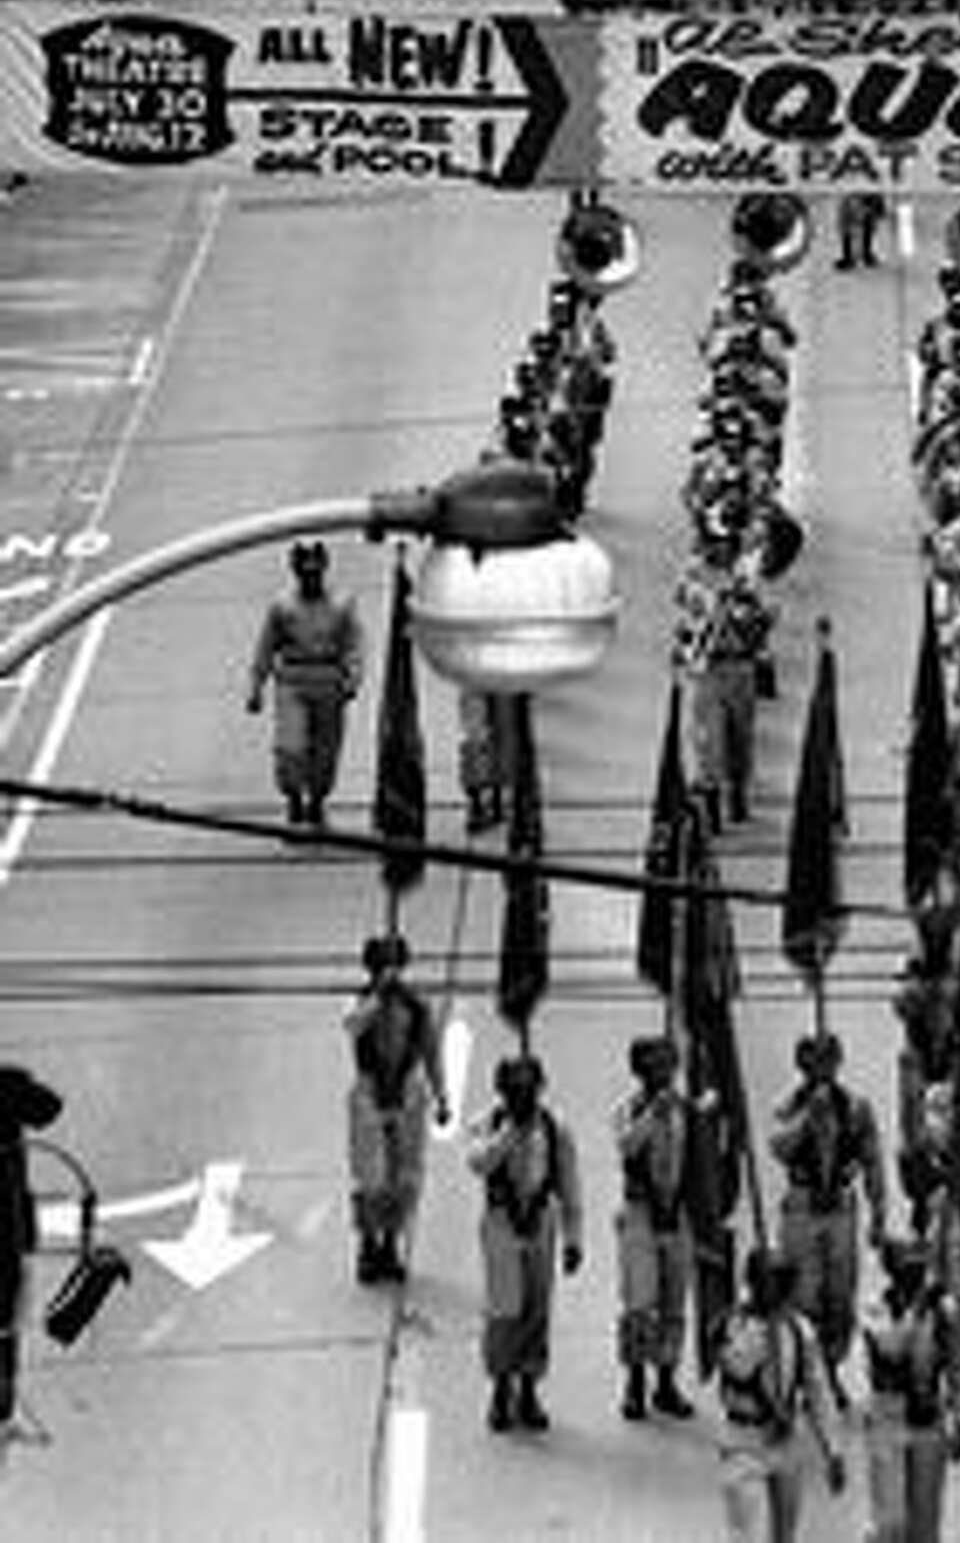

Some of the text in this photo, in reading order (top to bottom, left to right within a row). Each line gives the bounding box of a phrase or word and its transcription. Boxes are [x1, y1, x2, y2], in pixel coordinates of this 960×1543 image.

[258, 13, 495, 91] ALL NEW!
[260, 110, 454, 144] STAGE
[657, 143, 787, 185] with
[801, 145, 918, 183] PAT
